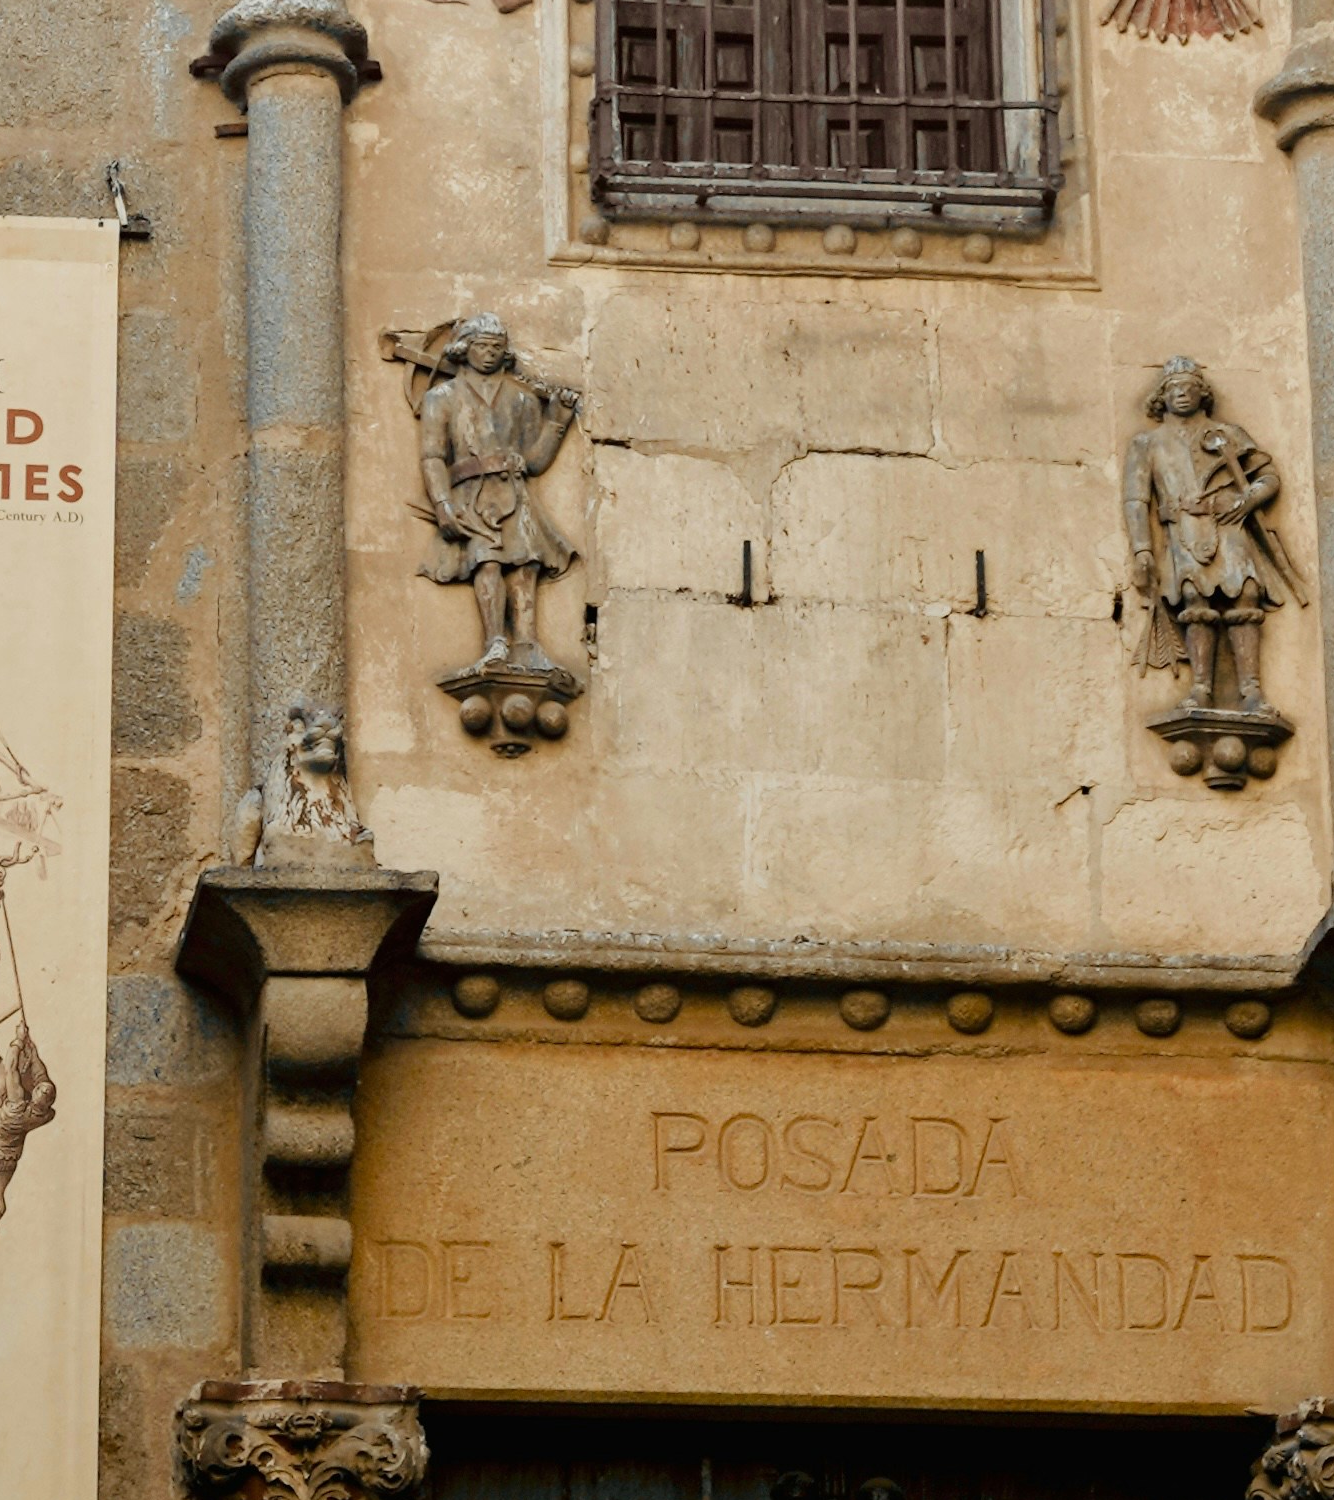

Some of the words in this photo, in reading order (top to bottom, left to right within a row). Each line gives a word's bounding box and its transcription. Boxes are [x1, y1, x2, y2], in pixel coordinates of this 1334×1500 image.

[52, 509, 85, 526] A.D)
[649, 1110, 1027, 1202] POSADA
[373, 1238, 494, 1323] DE
[544, 1238, 657, 1330] LA
[712, 1242, 1297, 1336] HERMANDAD
